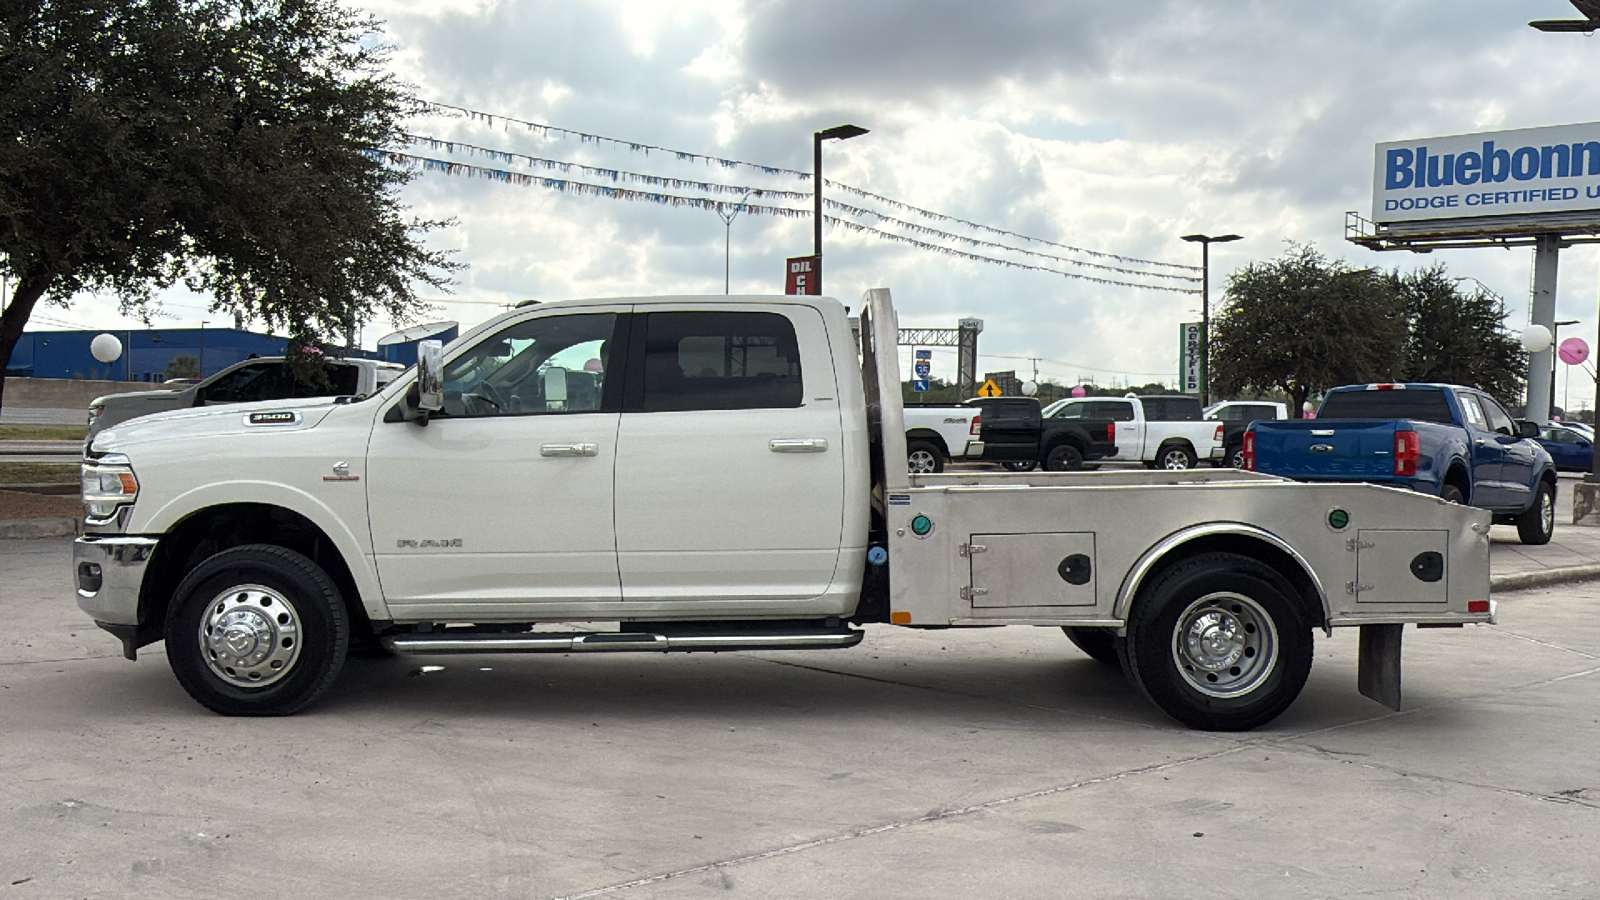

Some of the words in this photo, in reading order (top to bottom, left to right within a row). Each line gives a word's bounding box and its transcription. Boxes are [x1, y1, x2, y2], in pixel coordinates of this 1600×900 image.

[1385, 140, 1600, 190] Bluebonn
[1385, 194, 1459, 211] DODGE
[1465, 187, 1578, 206] CERTIFIED
[791, 261, 813, 273] OIL
[917, 366, 929, 376] 35
[253, 413, 291, 421] 3500
[397, 539, 462, 548] RAM
